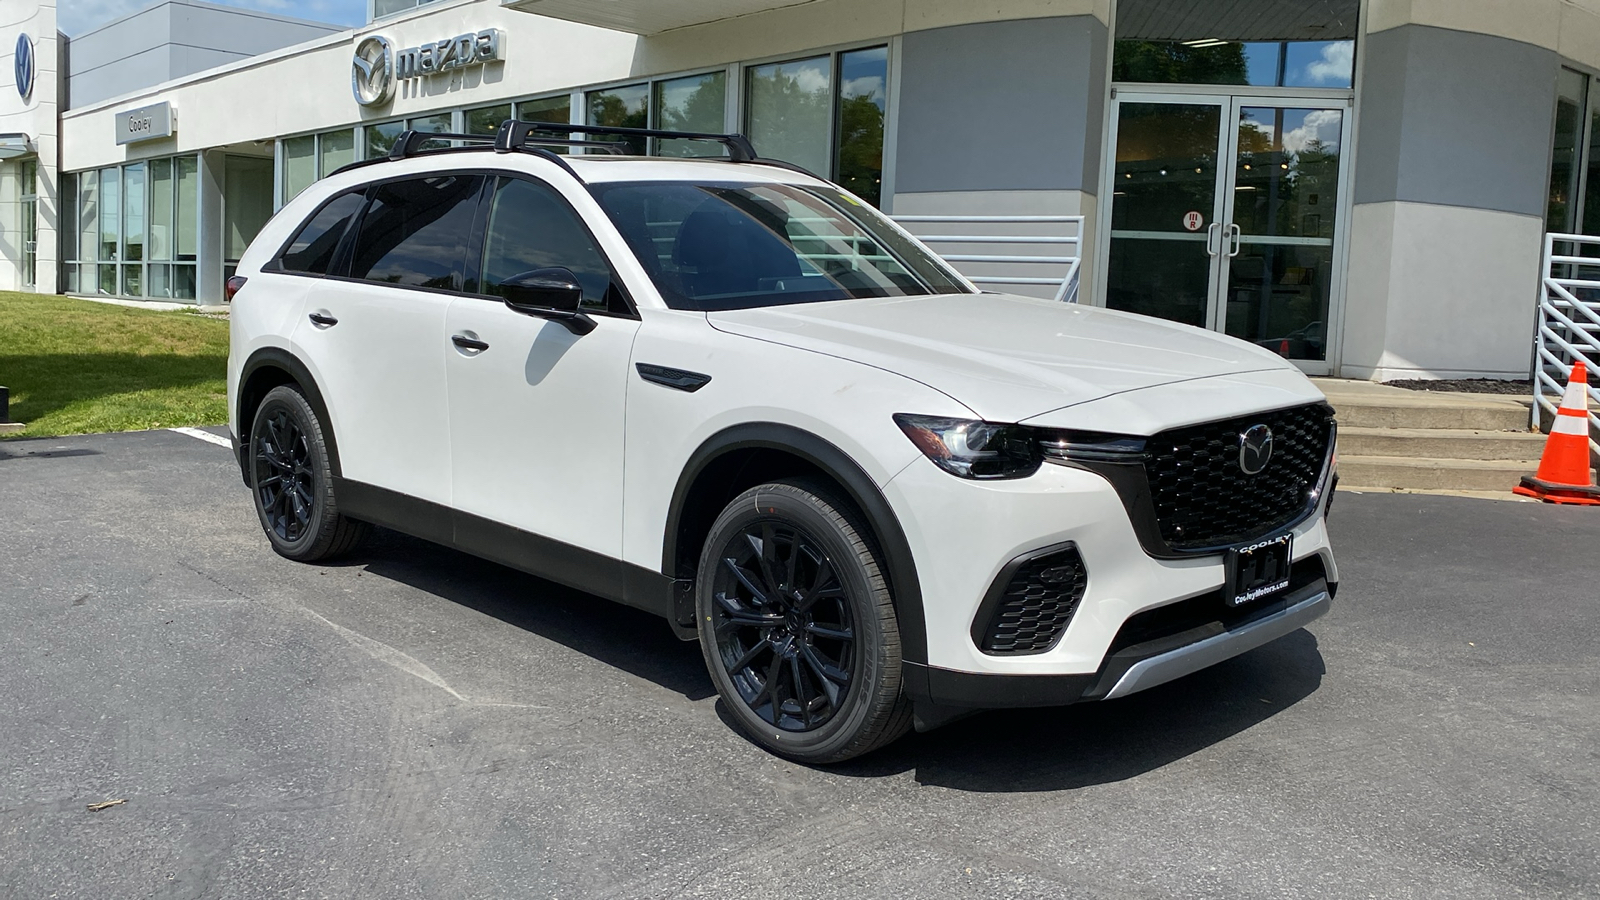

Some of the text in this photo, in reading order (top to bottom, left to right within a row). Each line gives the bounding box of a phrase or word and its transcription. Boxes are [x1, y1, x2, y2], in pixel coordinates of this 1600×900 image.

[396, 28, 500, 80] mazda
[128, 112, 152, 134] Cooley
[1240, 533, 1292, 553] COOLEY
[1235, 580, 1289, 604] CooleyMotors.com
